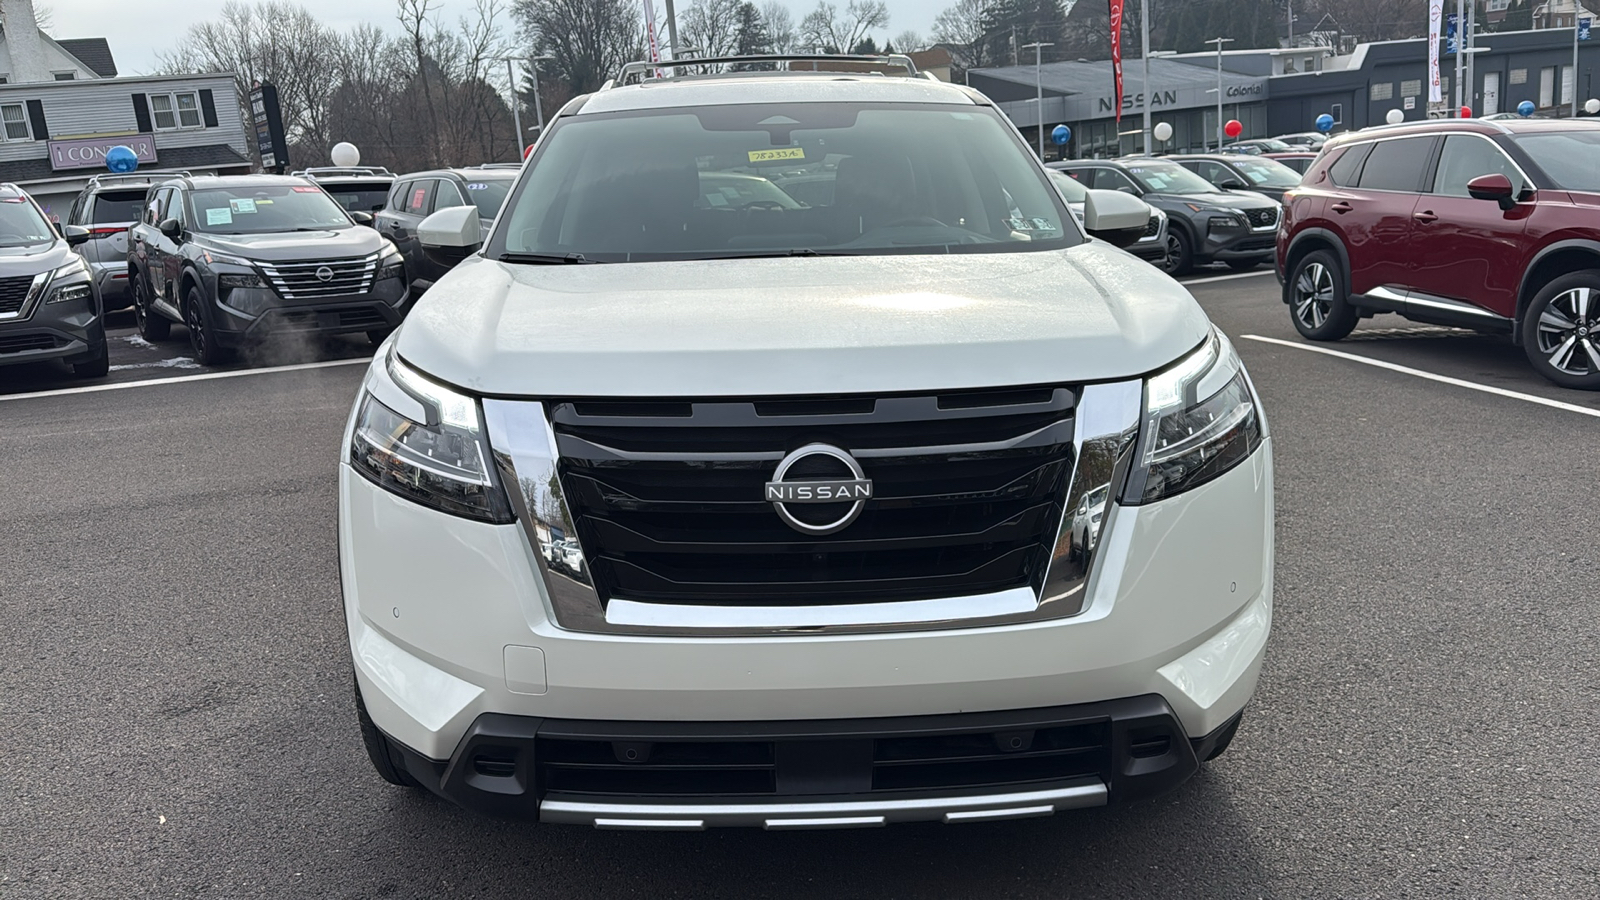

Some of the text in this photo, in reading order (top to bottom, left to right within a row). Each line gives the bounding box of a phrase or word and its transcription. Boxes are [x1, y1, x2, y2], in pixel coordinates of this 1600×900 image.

[1226, 83, 1264, 98] Colonial
[1099, 90, 1177, 113] NSSAN
[67, 143, 149, 161] CONR
[768, 483, 870, 499] NISSAN
